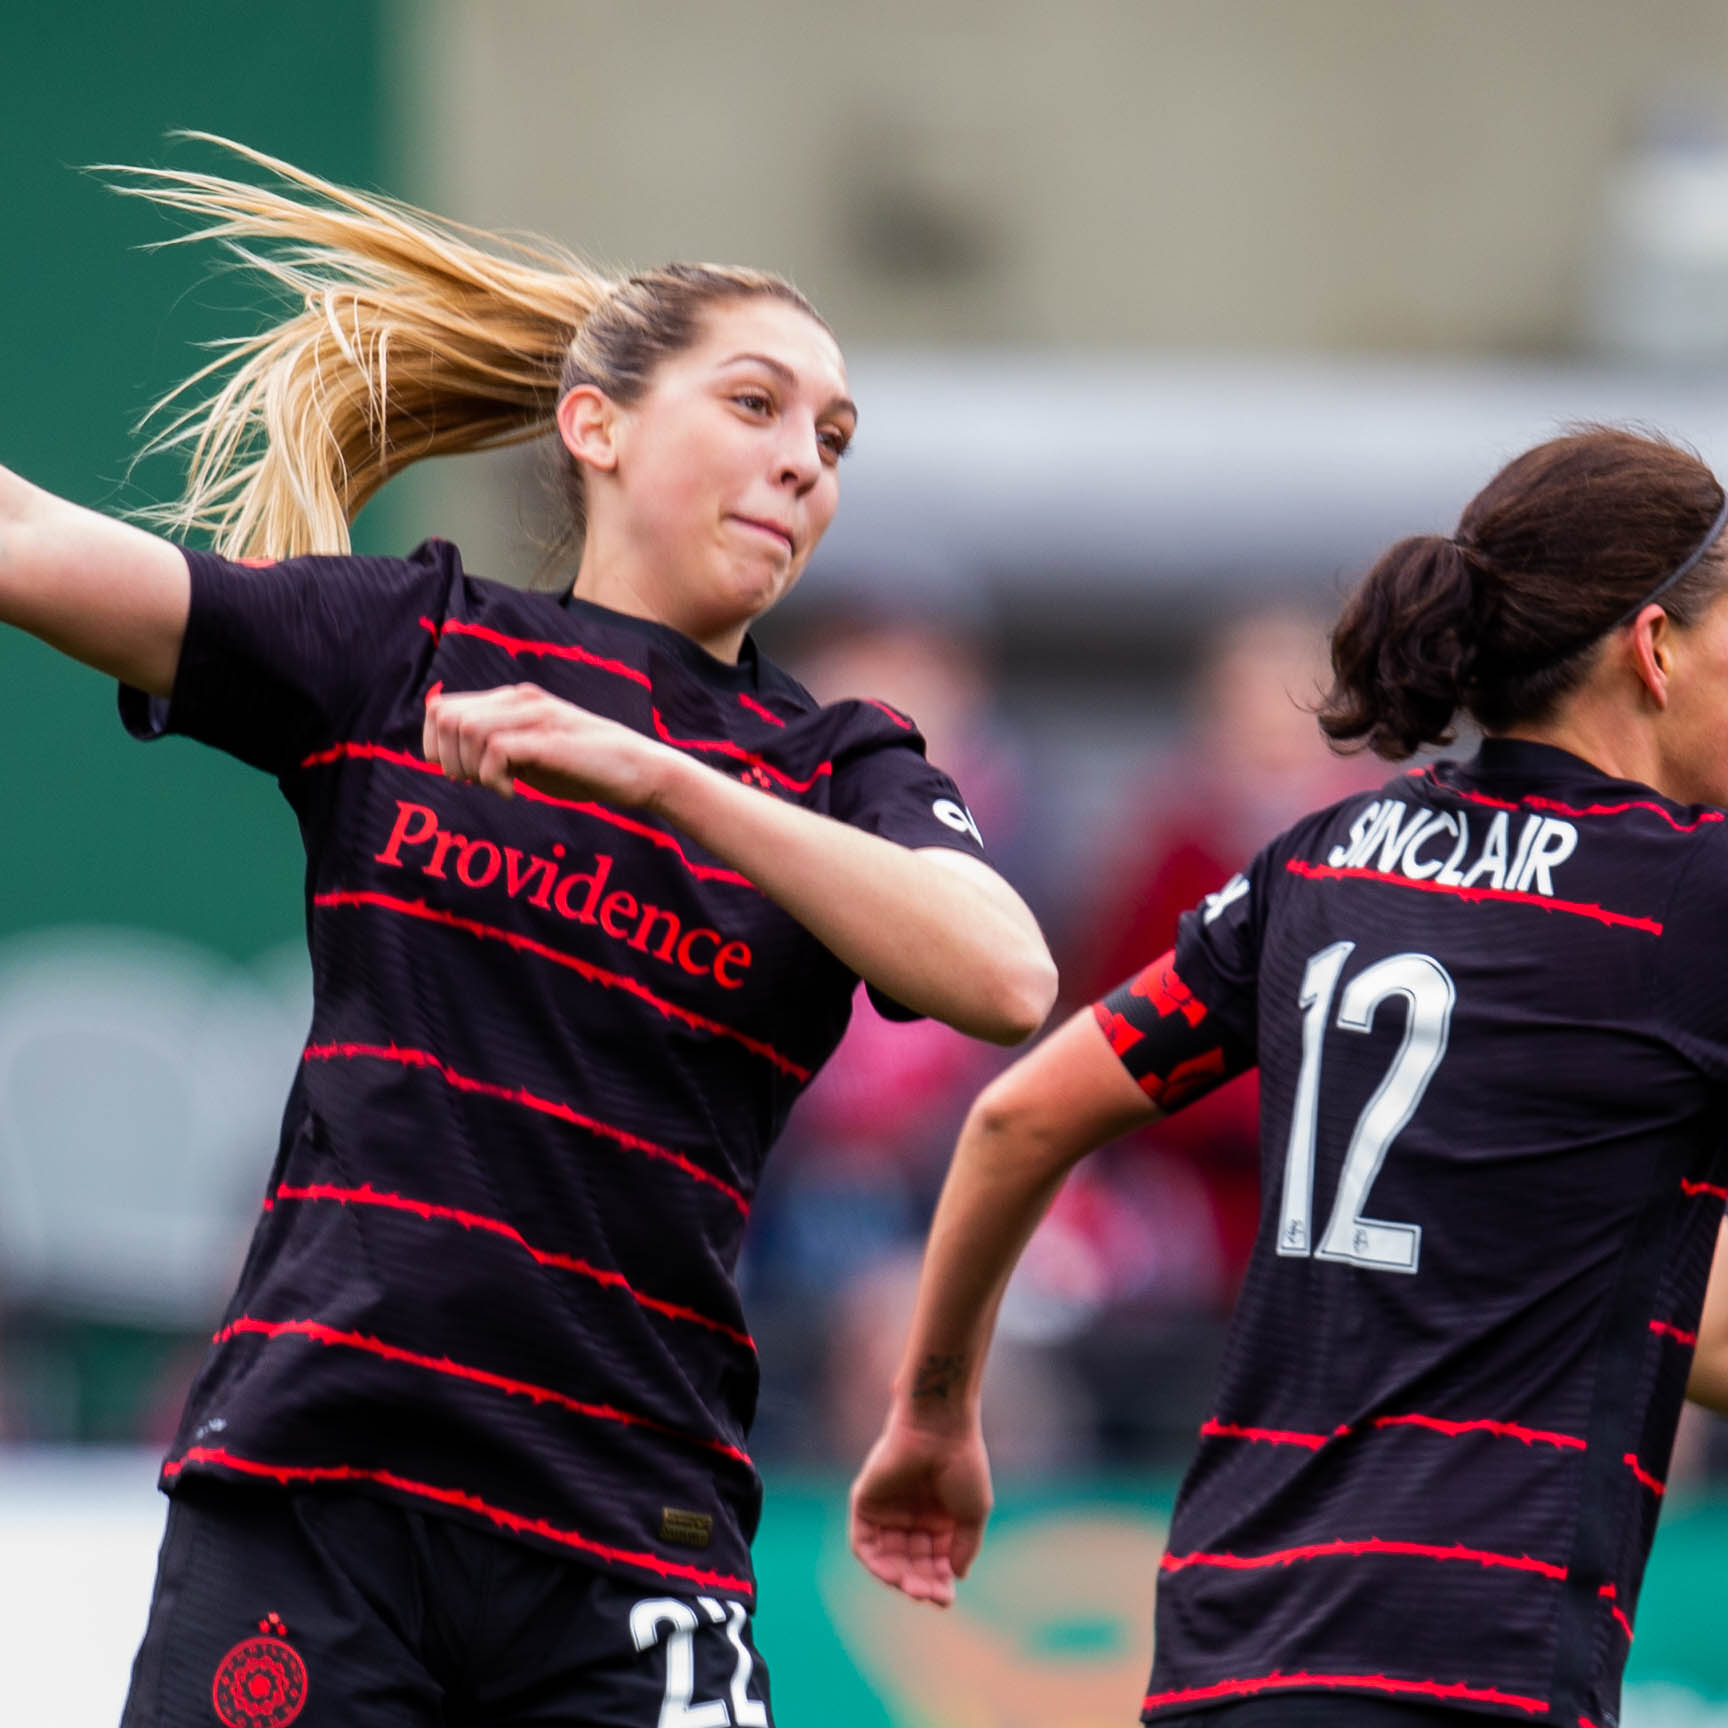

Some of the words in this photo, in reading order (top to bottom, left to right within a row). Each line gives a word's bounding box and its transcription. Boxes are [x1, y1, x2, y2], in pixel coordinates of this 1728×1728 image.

[374, 799, 754, 990] Providence
[1327, 798, 1579, 897] SINCLAIR
[1276, 941, 1457, 1274] 12
